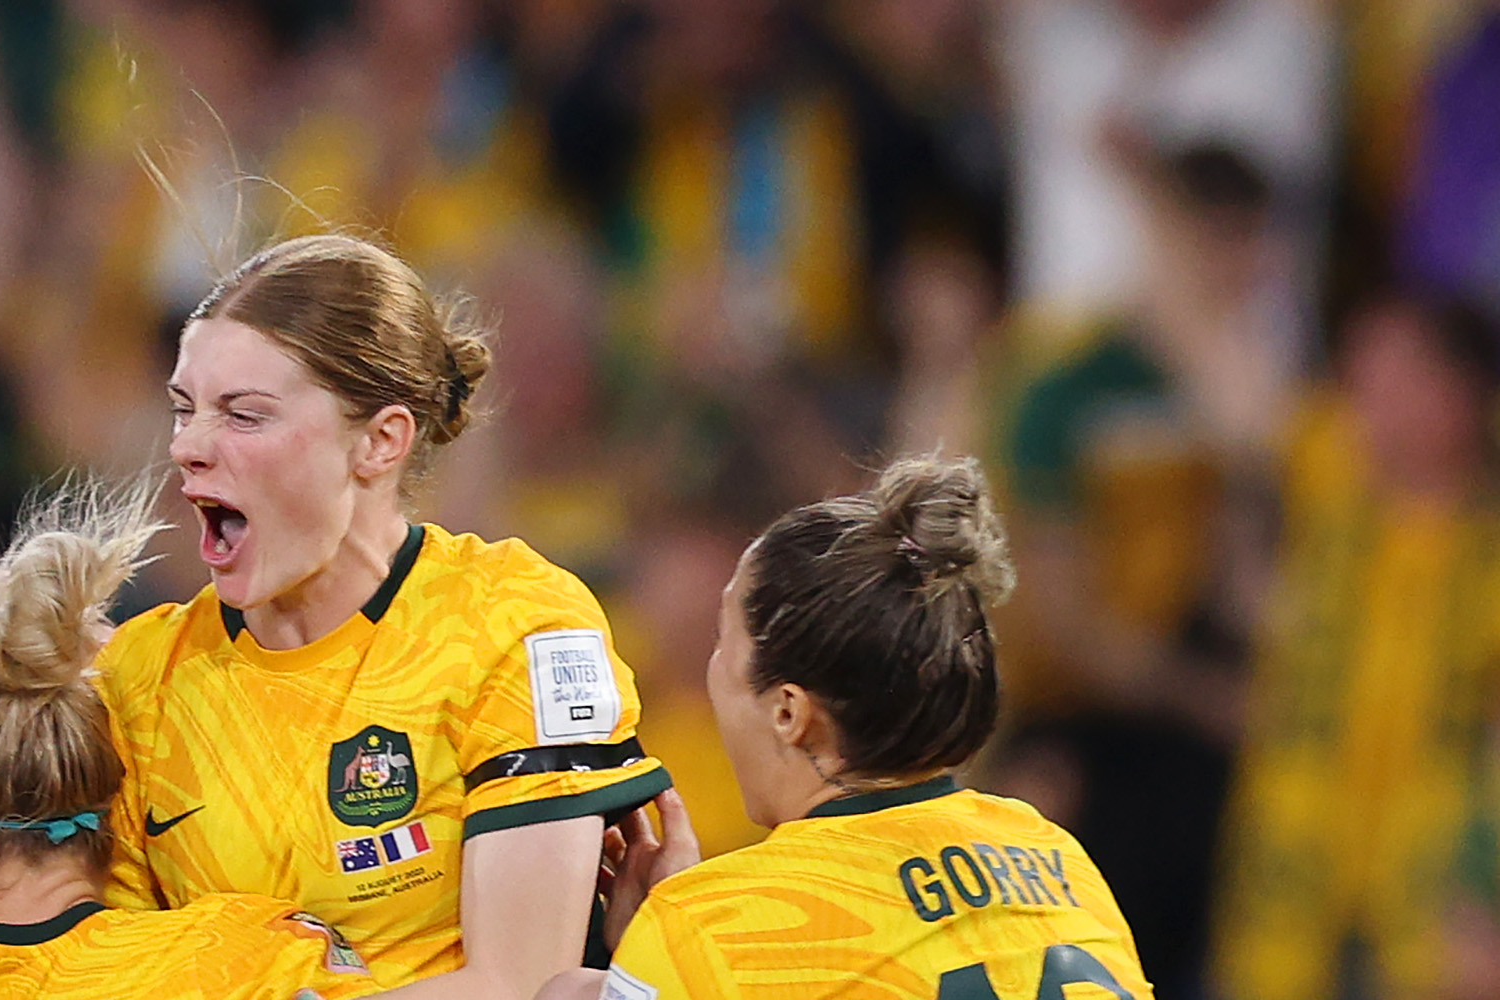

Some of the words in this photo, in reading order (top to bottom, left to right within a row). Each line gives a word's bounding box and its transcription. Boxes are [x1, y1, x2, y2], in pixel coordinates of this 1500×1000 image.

[553, 664, 598, 685] UNITES
[573, 684, 601, 701] Wor
[345, 786, 406, 803] AUSTRALIA
[393, 870, 444, 892] AUSTRALIA
[899, 841, 1080, 922] GORRY
